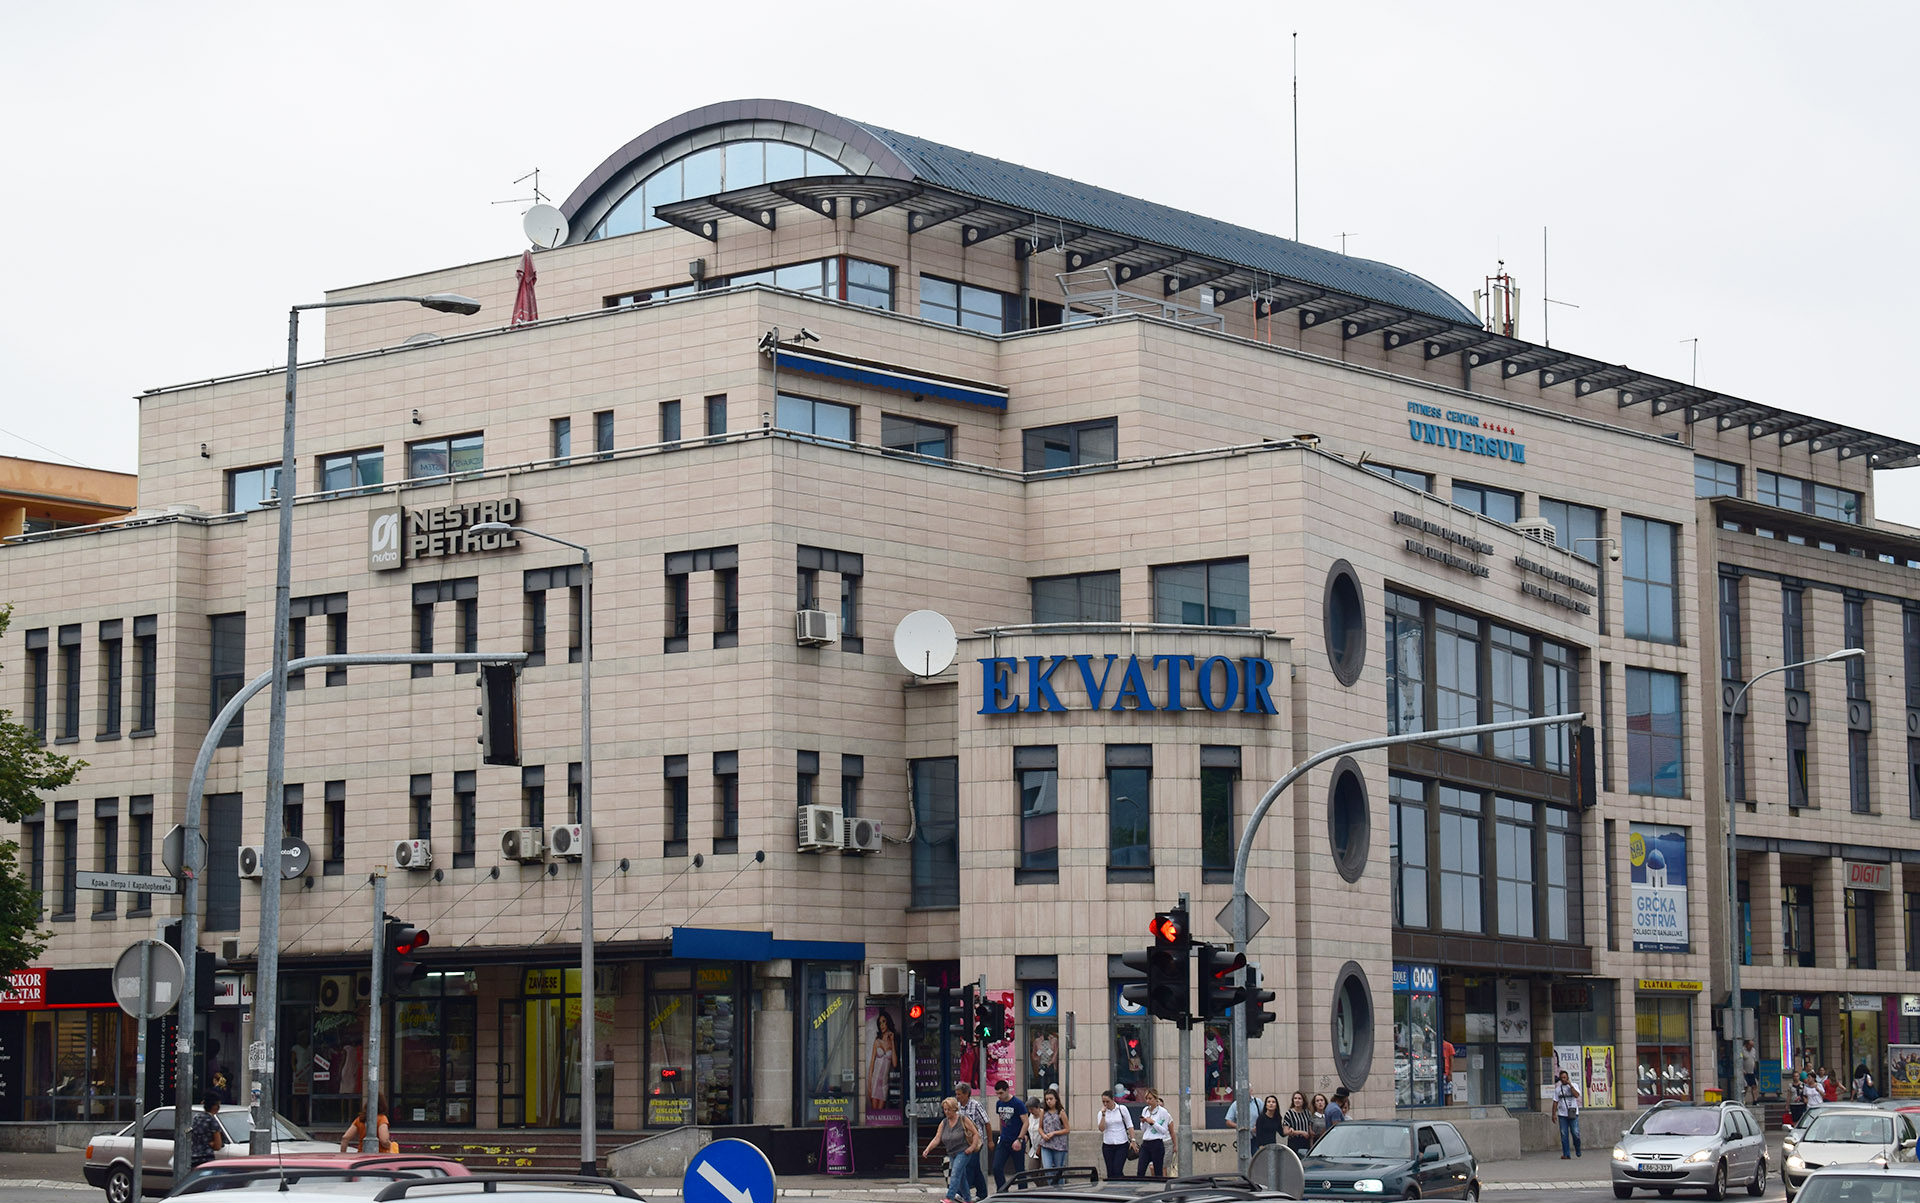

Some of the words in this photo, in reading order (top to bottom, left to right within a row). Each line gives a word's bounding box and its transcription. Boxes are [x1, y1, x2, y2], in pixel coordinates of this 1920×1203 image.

[1408, 401, 1442, 419] FITNESS
[1446, 410, 1480, 427] CENTAR
[1408, 419, 1526, 464] UNIVERSUM
[410, 497, 519, 533] NESTRO
[410, 526, 517, 559] PETROL
[372, 551, 398, 563] nestro
[977, 653, 1279, 715] EKVATOR
[1851, 864, 1885, 884] DIGIT
[1637, 891, 1676, 912] GRČKA
[1637, 912, 1677, 928] OSTRVA
[528, 976, 558, 989] ZAVJESE
[1643, 980, 1672, 989] ZLATARA
[1036, 995, 1048, 1007] R
[813, 996, 843, 1030] ZAVJESE
[1560, 1052, 1579, 1061] PERLA
[662, 1069, 676, 1077] Open
[1592, 1082, 1607, 1092] OAZA
[1192, 1140, 1227, 1153] never
